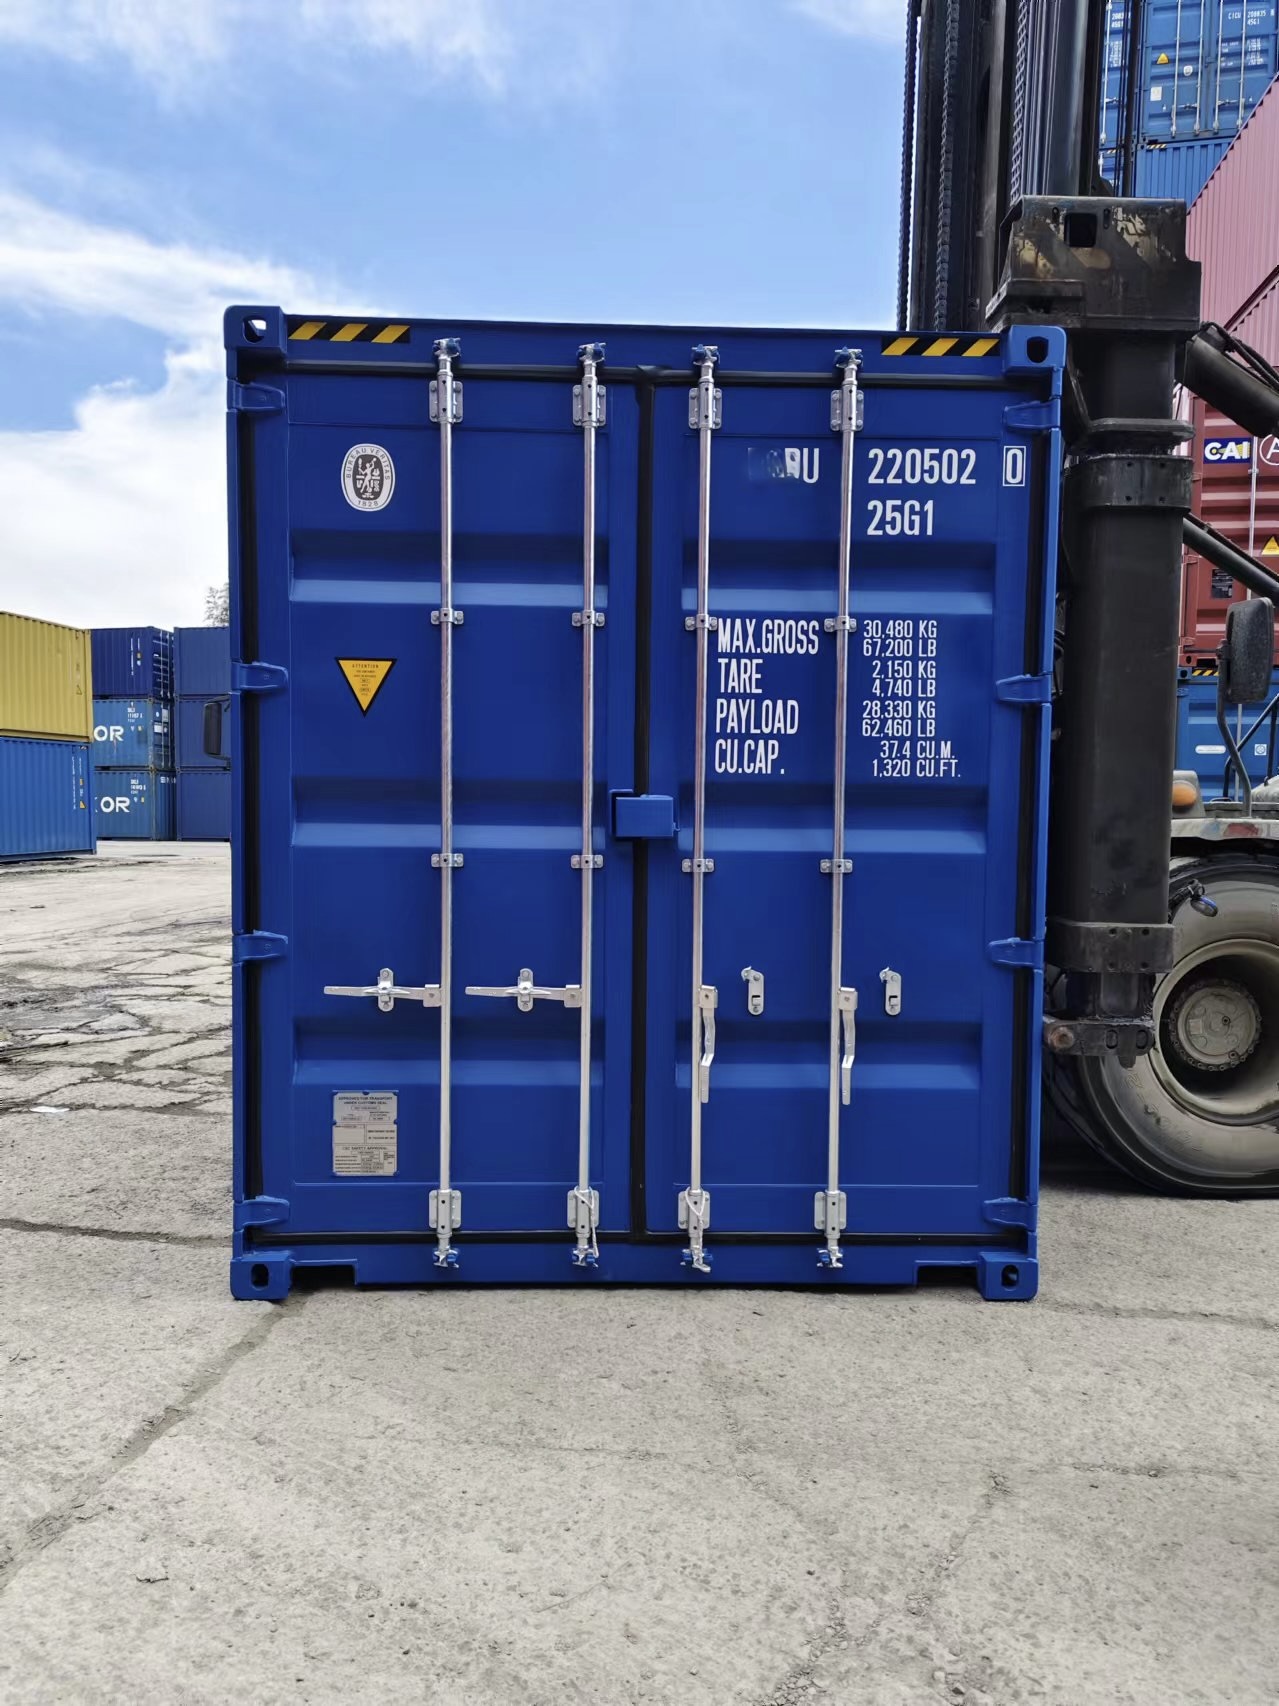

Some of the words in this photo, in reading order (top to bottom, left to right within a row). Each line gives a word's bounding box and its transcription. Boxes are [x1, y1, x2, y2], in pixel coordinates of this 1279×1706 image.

[1204, 441, 1250, 461] CAI
[345, 447, 367, 479] BUREAU
[369, 448, 391, 480] VERITAS
[868, 448, 976, 485] 220502
[1005, 448, 1024, 485] 0
[866, 499, 935, 536] 25G1
[717, 617, 820, 655] MAX.GROSS
[863, 619, 913, 639] 30,480
[919, 619, 938, 639] KG
[863, 638, 913, 658] 67,200
[918, 638, 937, 657] LB
[717, 658, 764, 694] TARE
[872, 660, 913, 679] 2,150
[918, 660, 937, 679] KG
[871, 678, 912, 698] 4,740
[917, 679, 936, 698] LB
[715, 698, 799, 735] PAYLOAD
[862, 700, 912, 719] 28,330
[917, 700, 936, 719] KG
[862, 718, 912, 738] 62,460
[917, 718, 936, 738] LB
[880, 740, 911, 759] 37.4
[916, 740, 955, 759] CU.M.
[872, 758, 911, 778] 1,320
[916, 759, 961, 778] CU.FT.
[94, 796, 130, 813] OR
